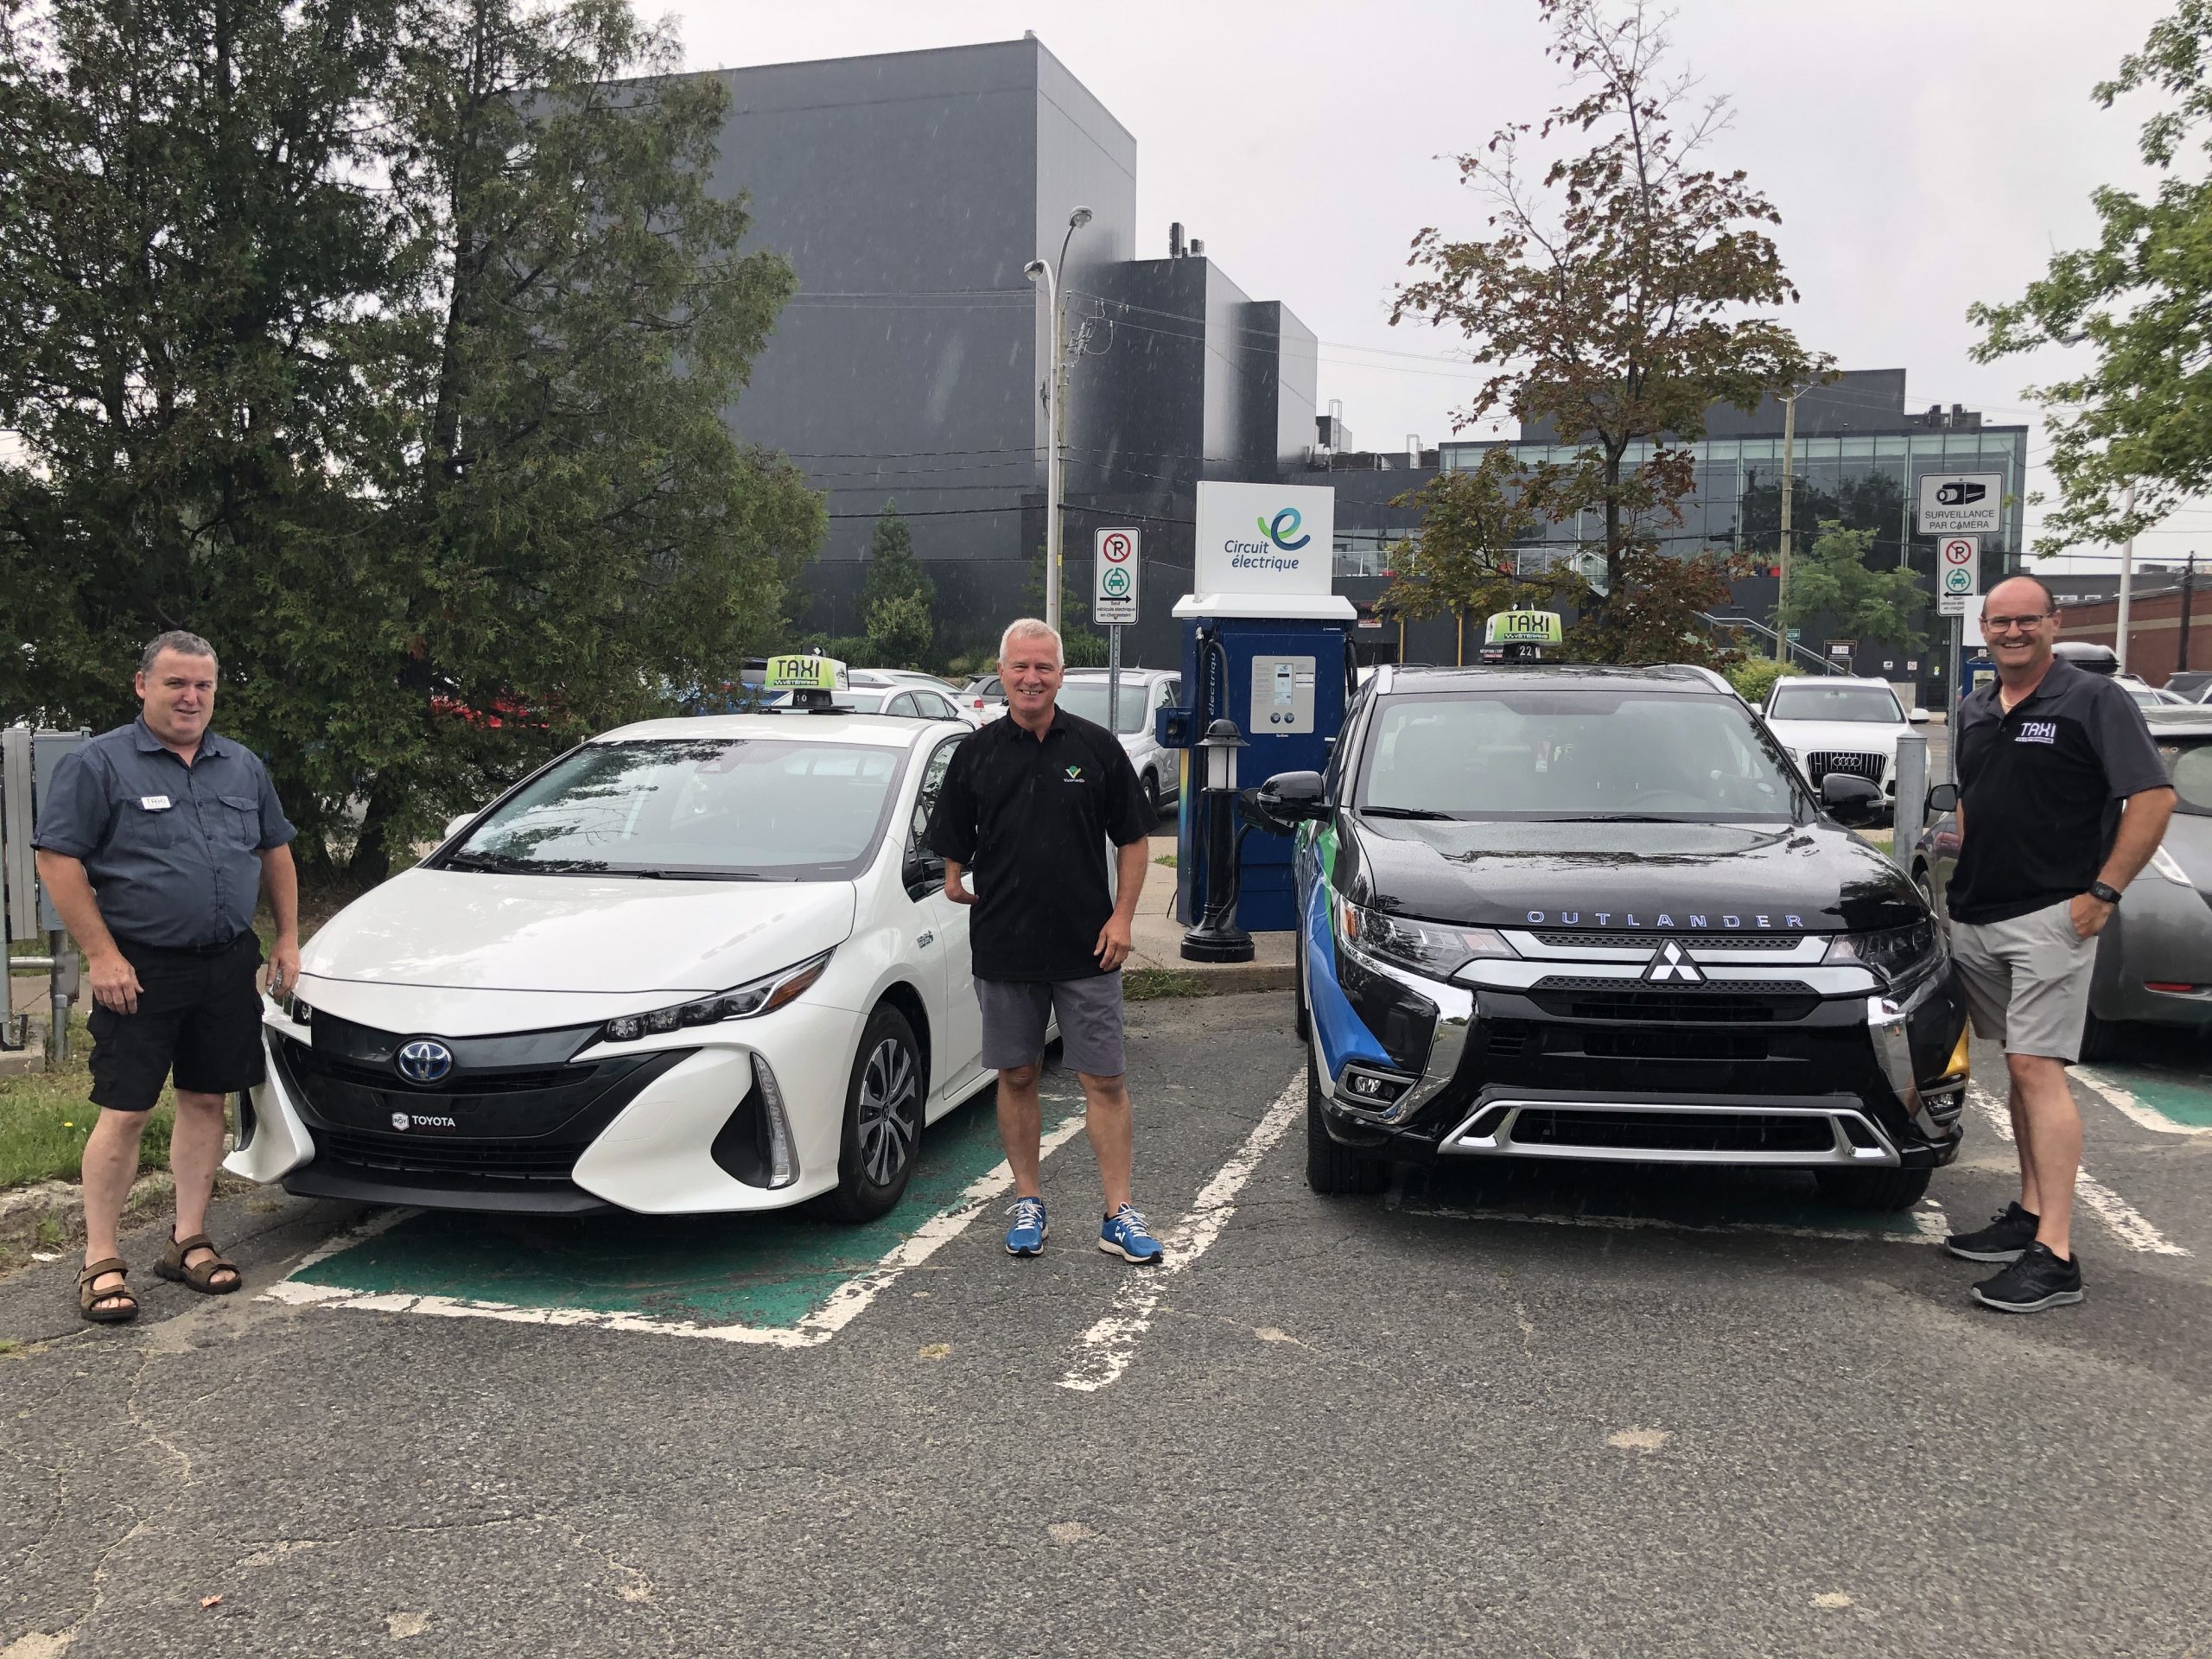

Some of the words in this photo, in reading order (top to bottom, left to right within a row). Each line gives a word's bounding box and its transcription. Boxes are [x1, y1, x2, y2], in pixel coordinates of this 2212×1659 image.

[1925, 510, 1995, 519] SURVEILLANCE
[1929, 521, 1948, 530] PAR
[1224, 540, 1269, 554] Circuit
[1231, 554, 1300, 572] électrique
[1519, 645, 1532, 657] 22
[1208, 652, 1217, 716] électriqu
[796, 694, 807, 702] 10
[1527, 910, 1804, 928] OUTLANDER
[411, 1115, 456, 1127] TOYOTA
